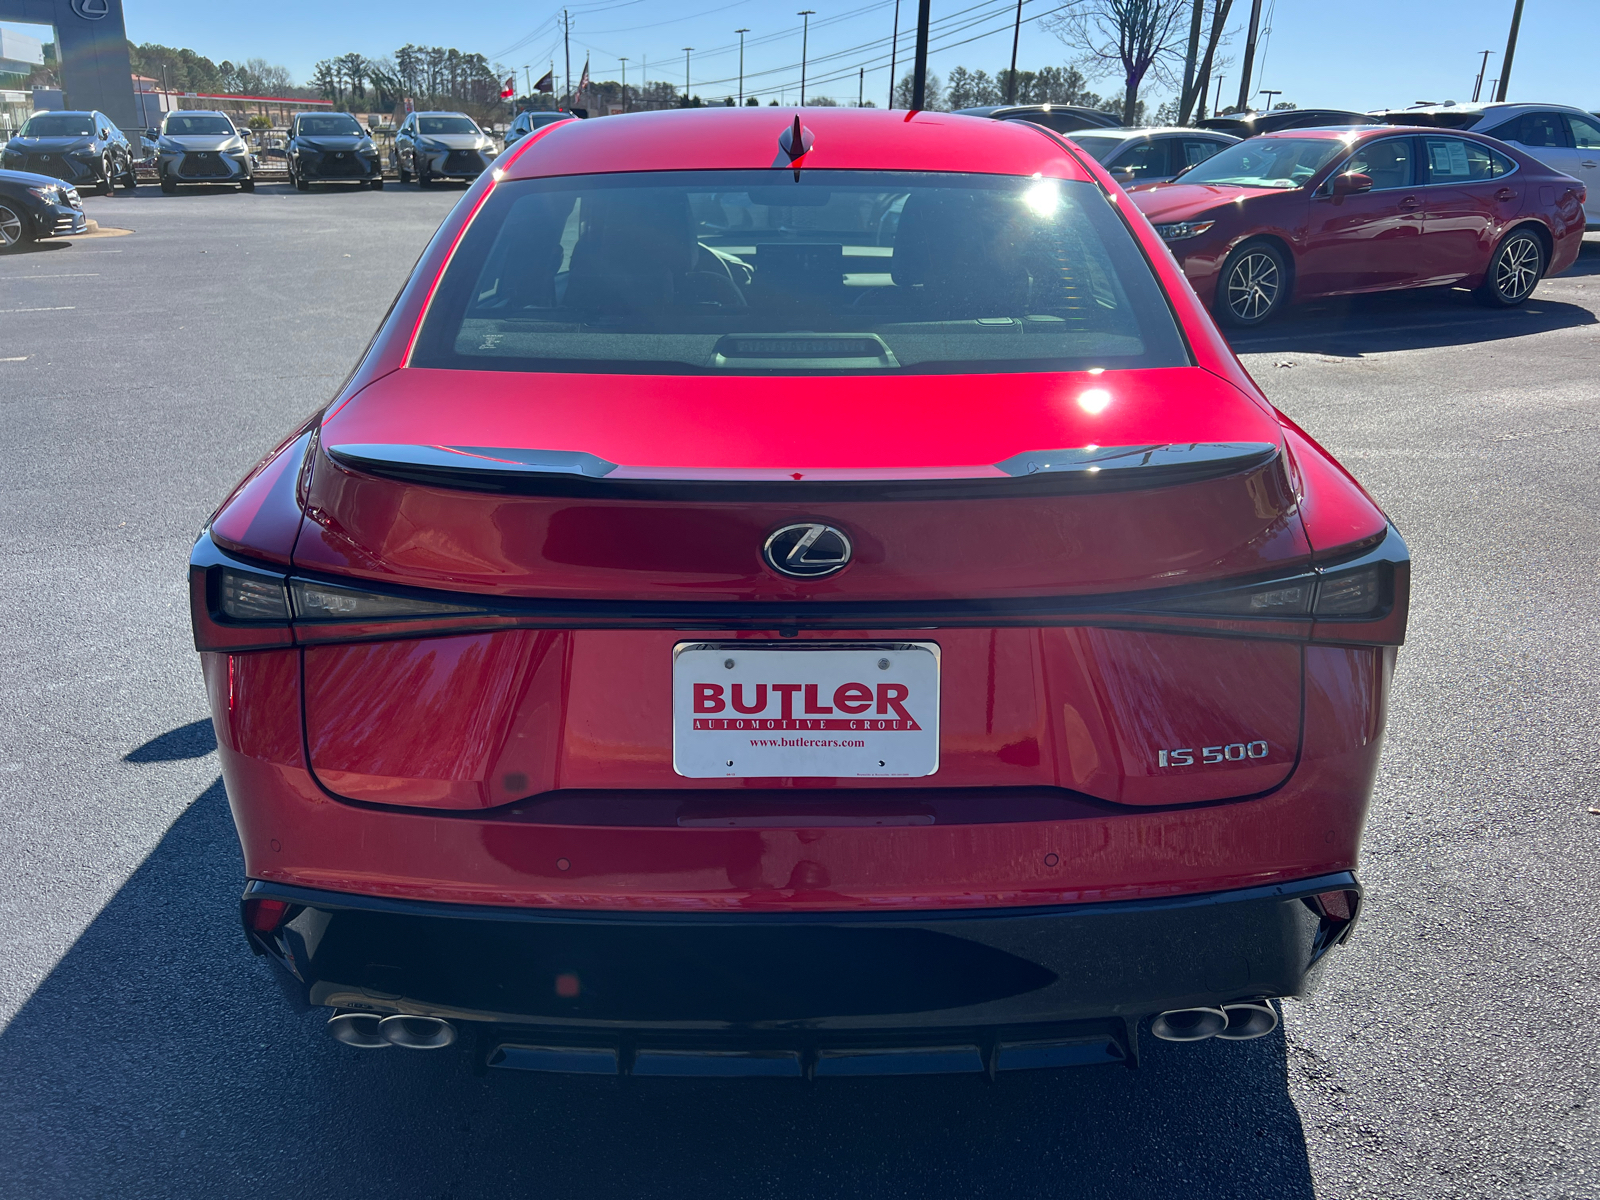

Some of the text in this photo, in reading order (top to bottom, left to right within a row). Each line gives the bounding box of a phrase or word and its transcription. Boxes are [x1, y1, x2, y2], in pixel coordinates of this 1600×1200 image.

[694, 720, 915, 729] AUTOMOTIVE GROUP
[750, 737, 866, 748] www.butlercars.com
[1158, 740, 1269, 768] IS 500
